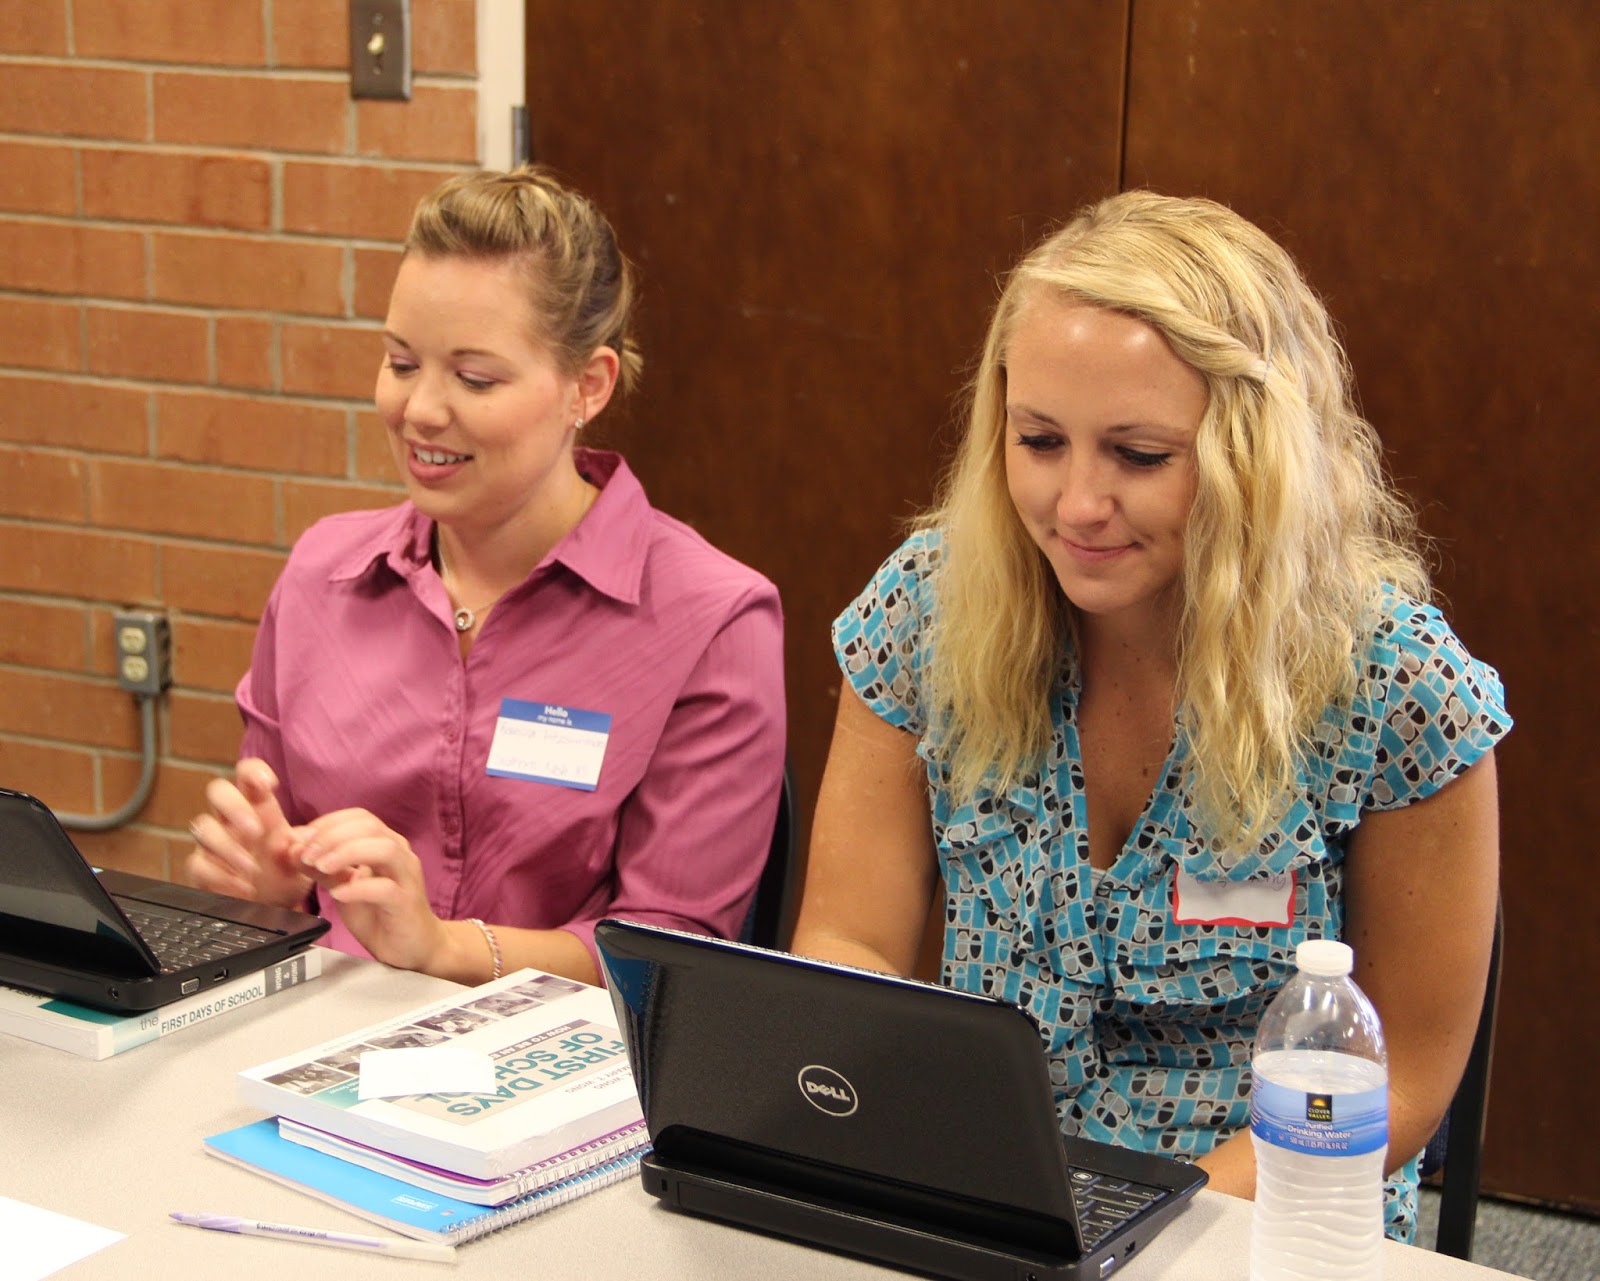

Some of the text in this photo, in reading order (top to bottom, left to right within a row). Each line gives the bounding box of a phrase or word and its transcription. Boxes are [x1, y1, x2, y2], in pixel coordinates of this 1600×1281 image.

[544, 705, 568, 718] Hello
[140, 985, 263, 1033] the FIRST DAYS OF SCHOOL
[559, 1033, 603, 1053] OF
[447, 1040, 626, 1116] FIRST DAYS
[806, 1081, 850, 1102] DELL
[1287, 1124, 1352, 1139] Drinking Water
[1305, 1121, 1333, 1130] Purified
